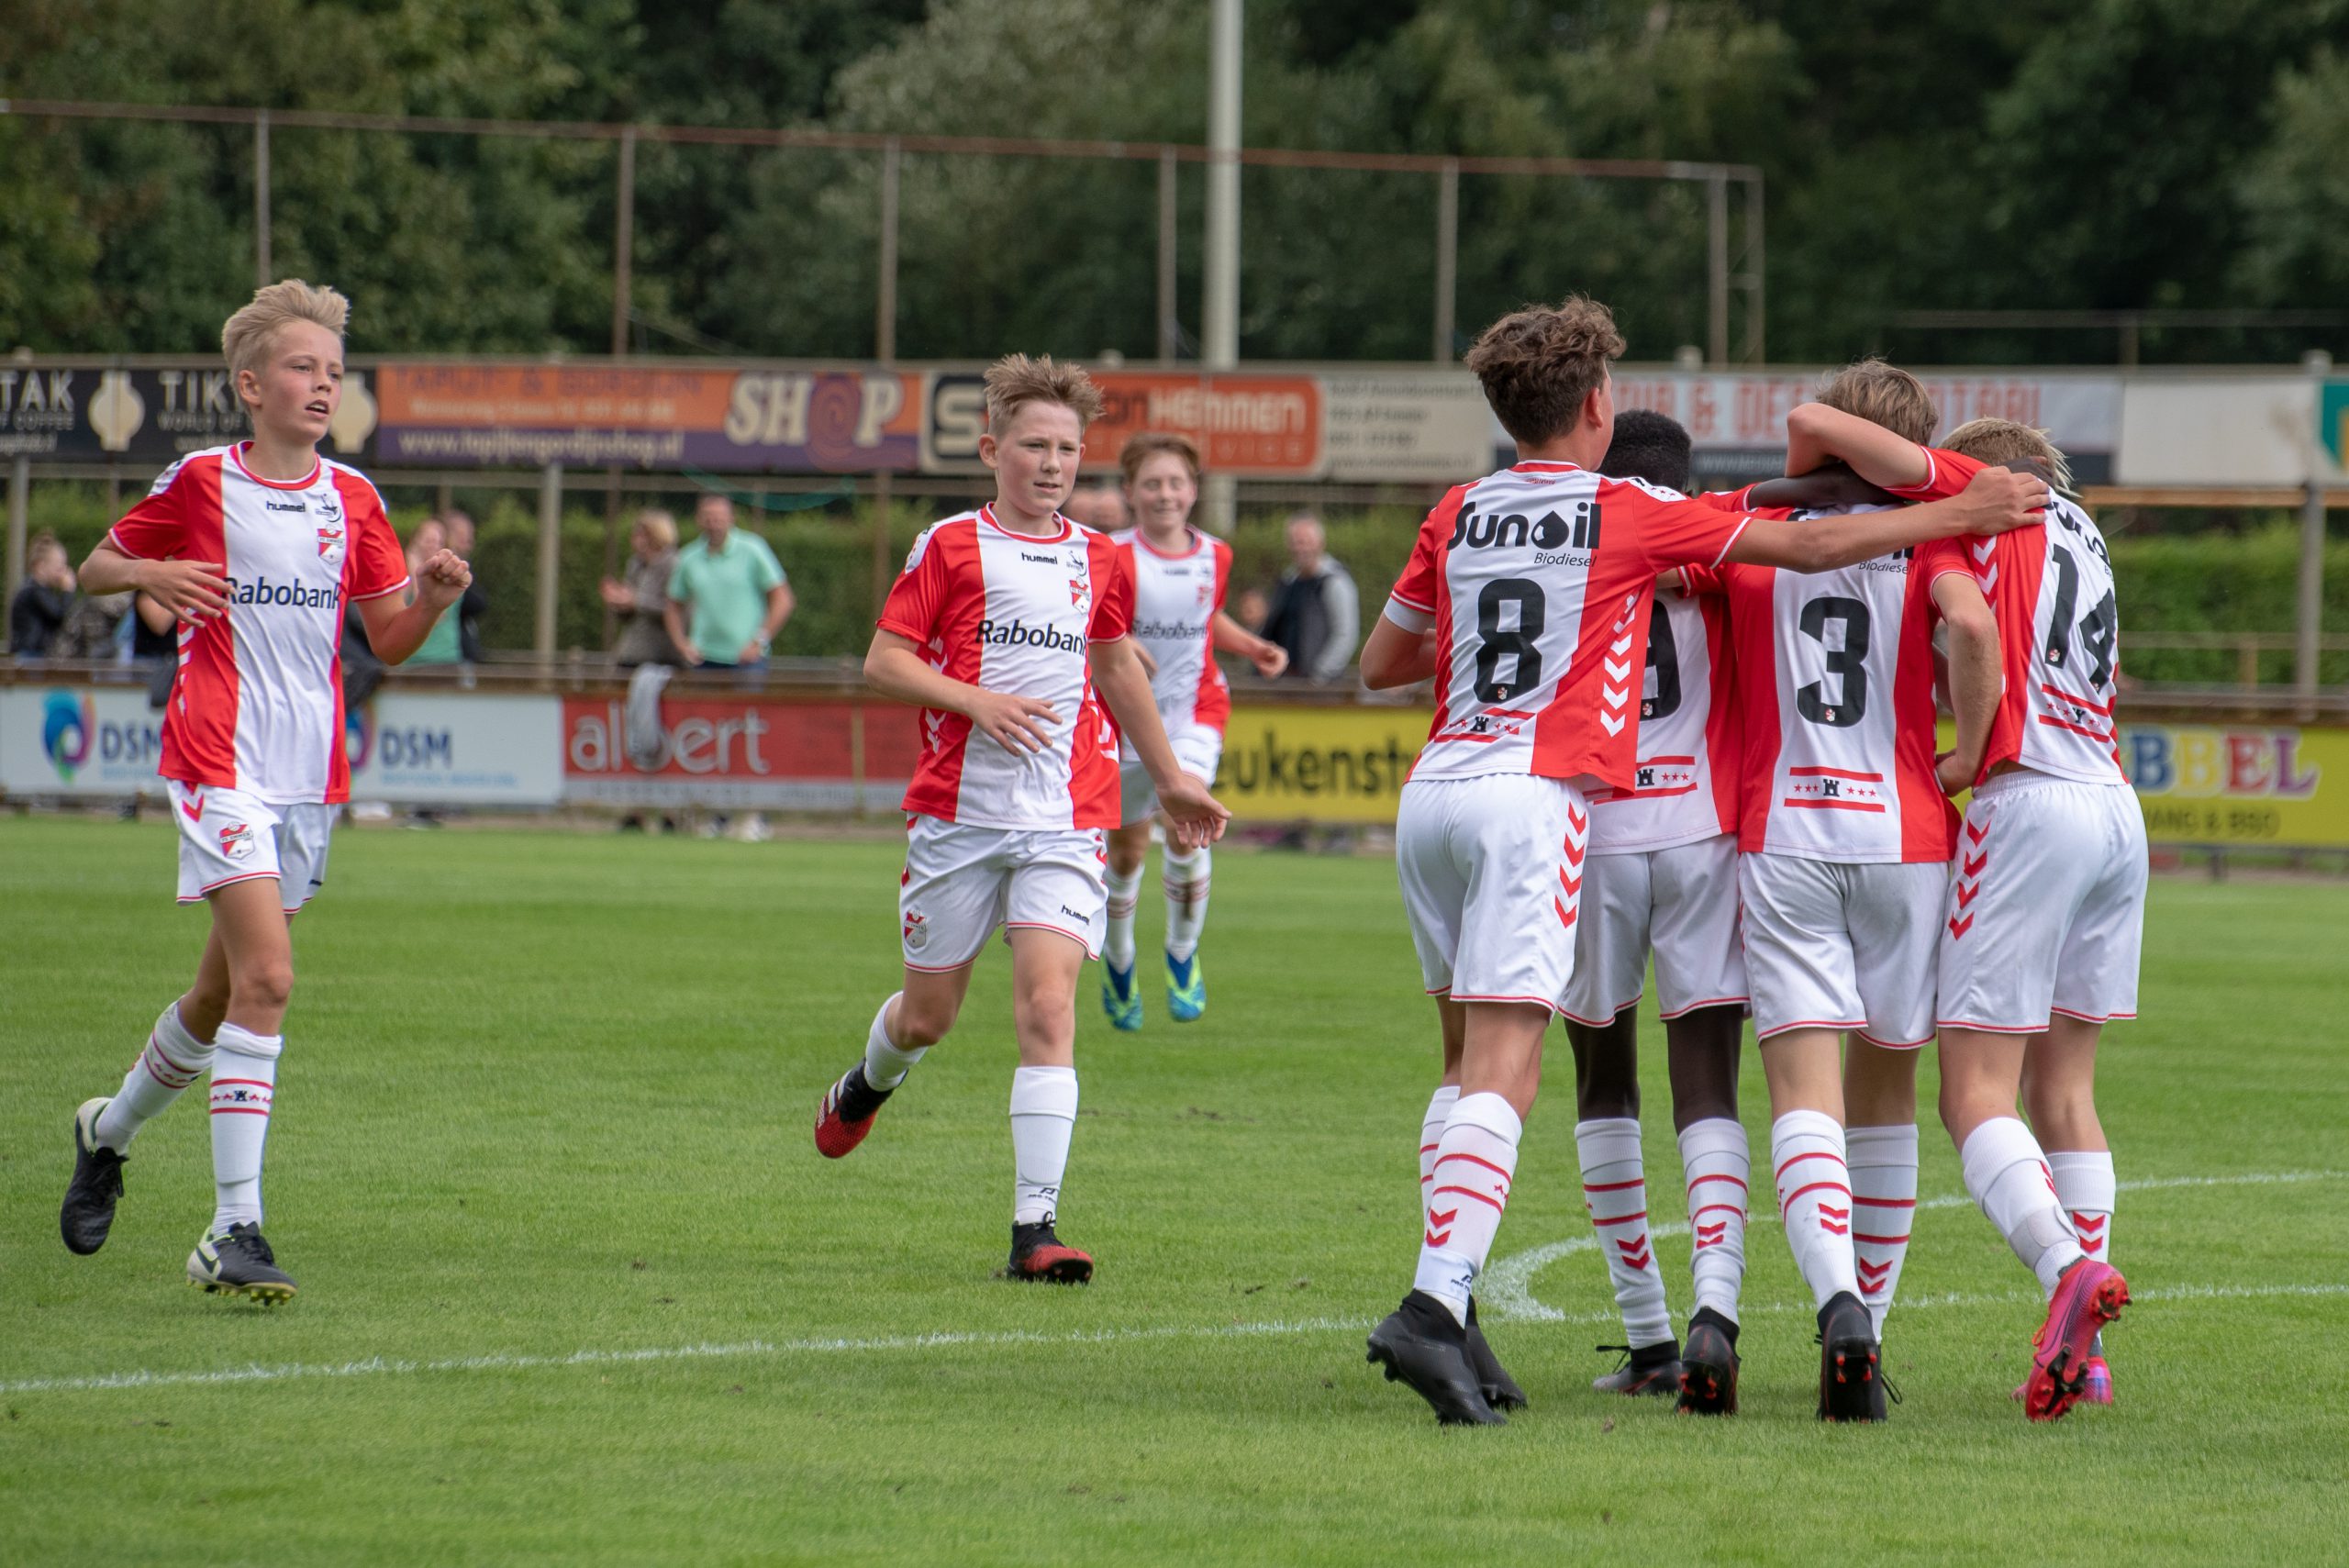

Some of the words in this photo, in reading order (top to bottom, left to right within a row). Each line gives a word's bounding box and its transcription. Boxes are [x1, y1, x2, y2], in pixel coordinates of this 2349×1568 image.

[266, 501, 306, 513] hummel
[1021, 552, 1058, 565] hummel
[1533, 552, 1598, 568] Biodiesel
[1473, 578, 1546, 704] 8
[2044, 543, 2116, 695] 14
[1797, 596, 1871, 728] 3
[379, 729, 453, 768] DSM
[2121, 727, 2323, 795] BBEL
